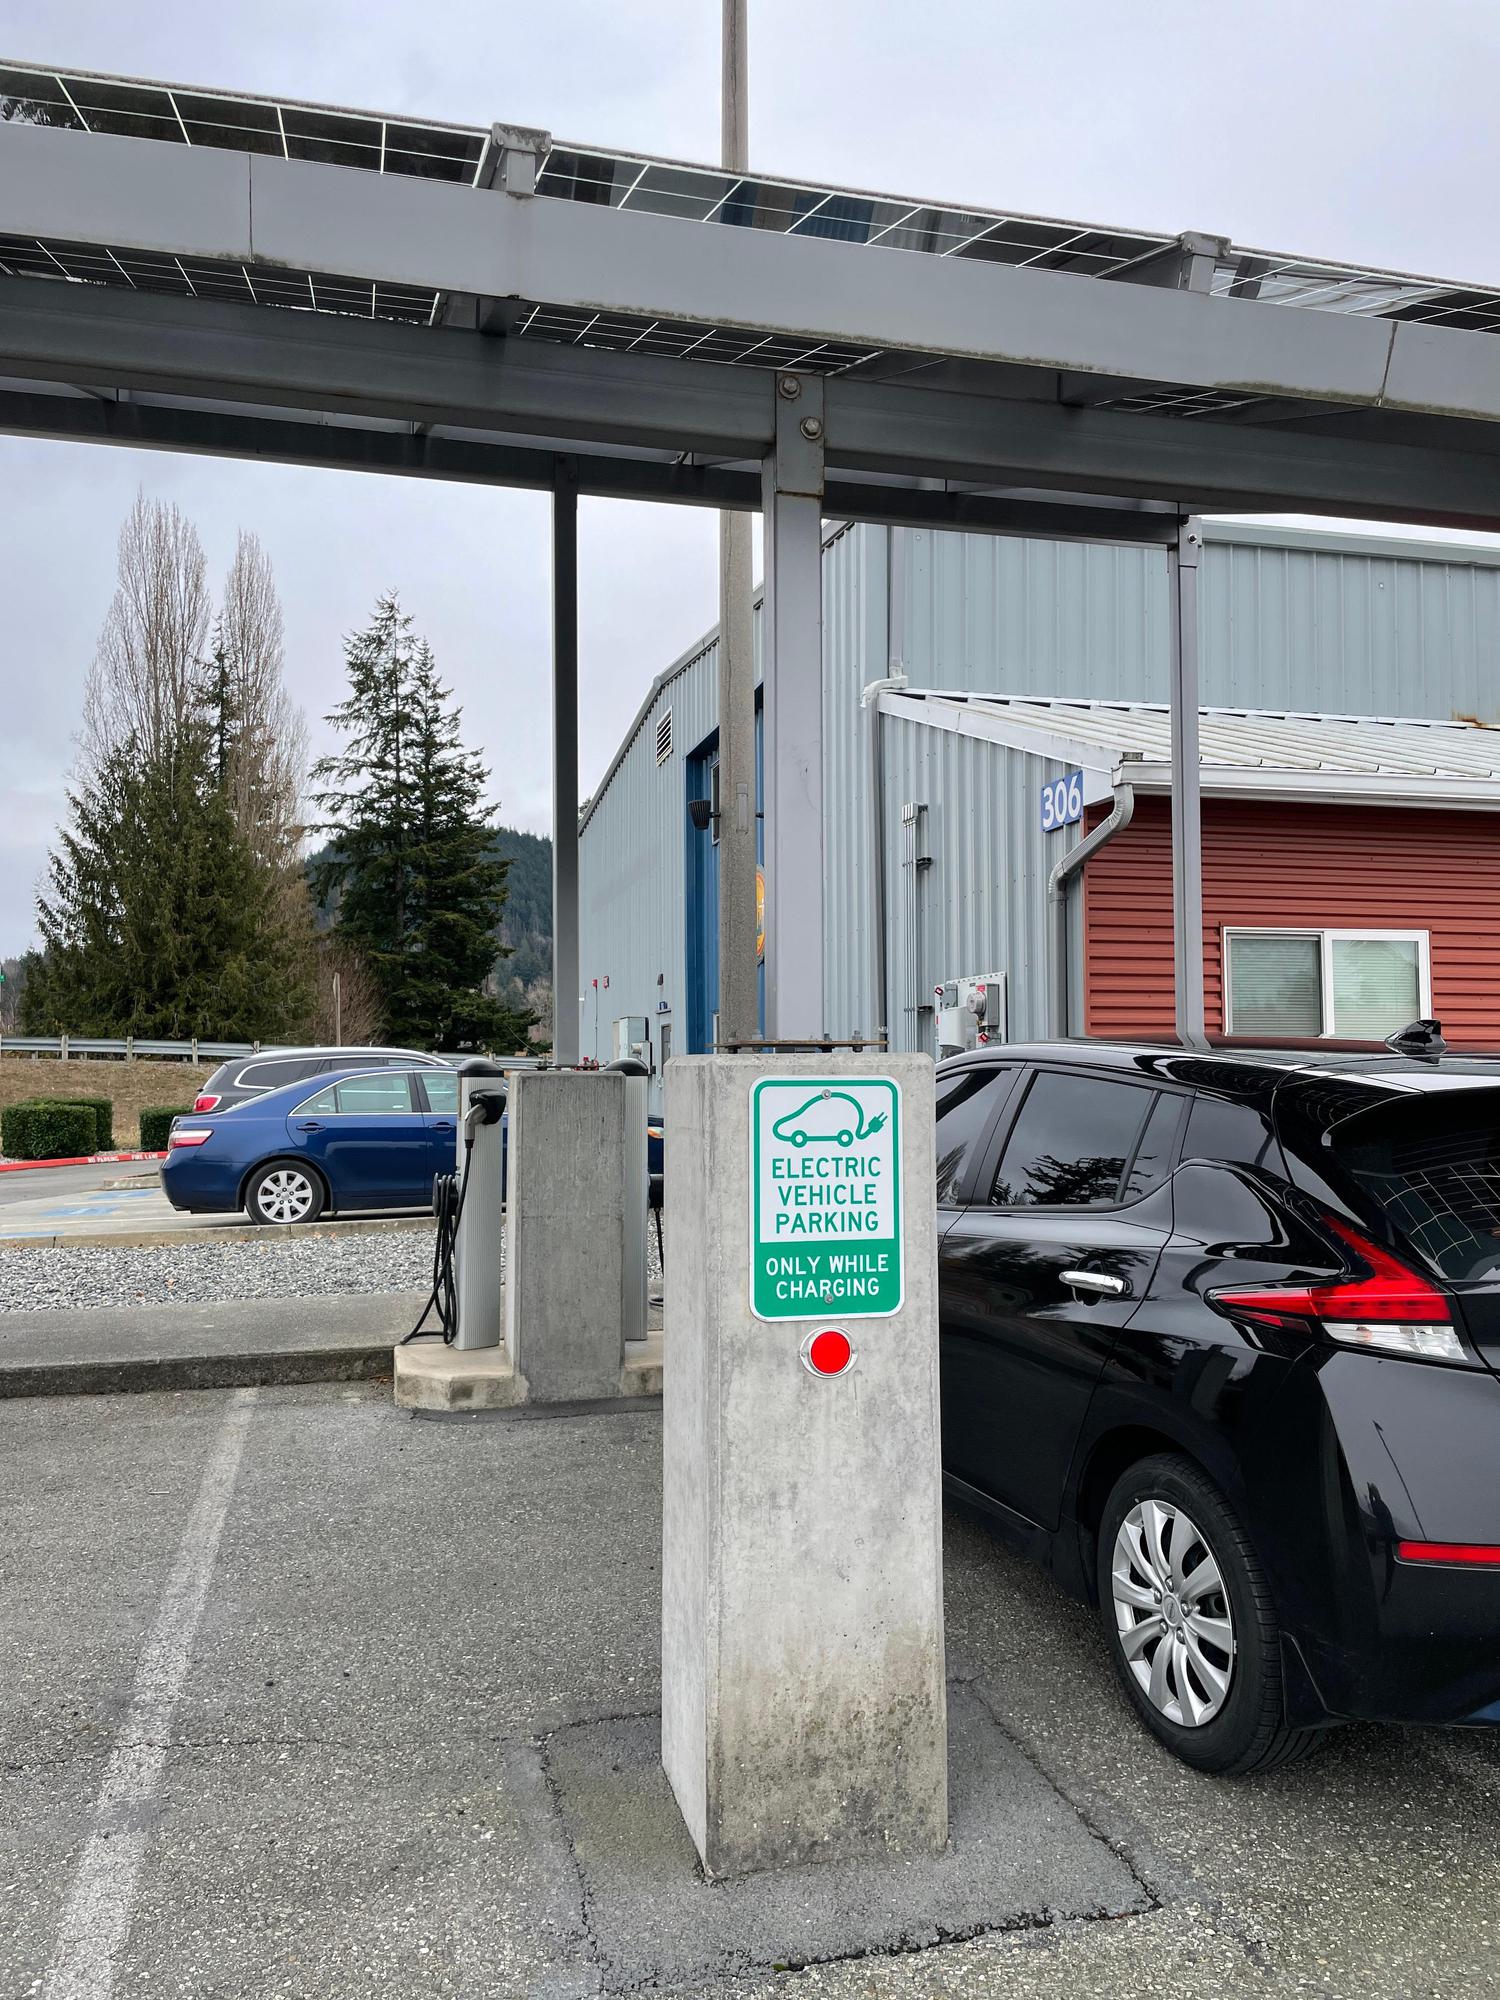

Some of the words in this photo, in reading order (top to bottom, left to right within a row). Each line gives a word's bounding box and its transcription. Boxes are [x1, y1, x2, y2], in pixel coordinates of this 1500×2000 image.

[1043, 775, 1081, 828] 306
[772, 1156, 881, 1179] ELECTRIC
[777, 1183, 877, 1207] VEHICLE
[775, 1210, 879, 1234] PARKING
[765, 1255, 821, 1276] ONLY
[828, 1253, 889, 1274] WHILE
[775, 1277, 880, 1300] CHARGING
